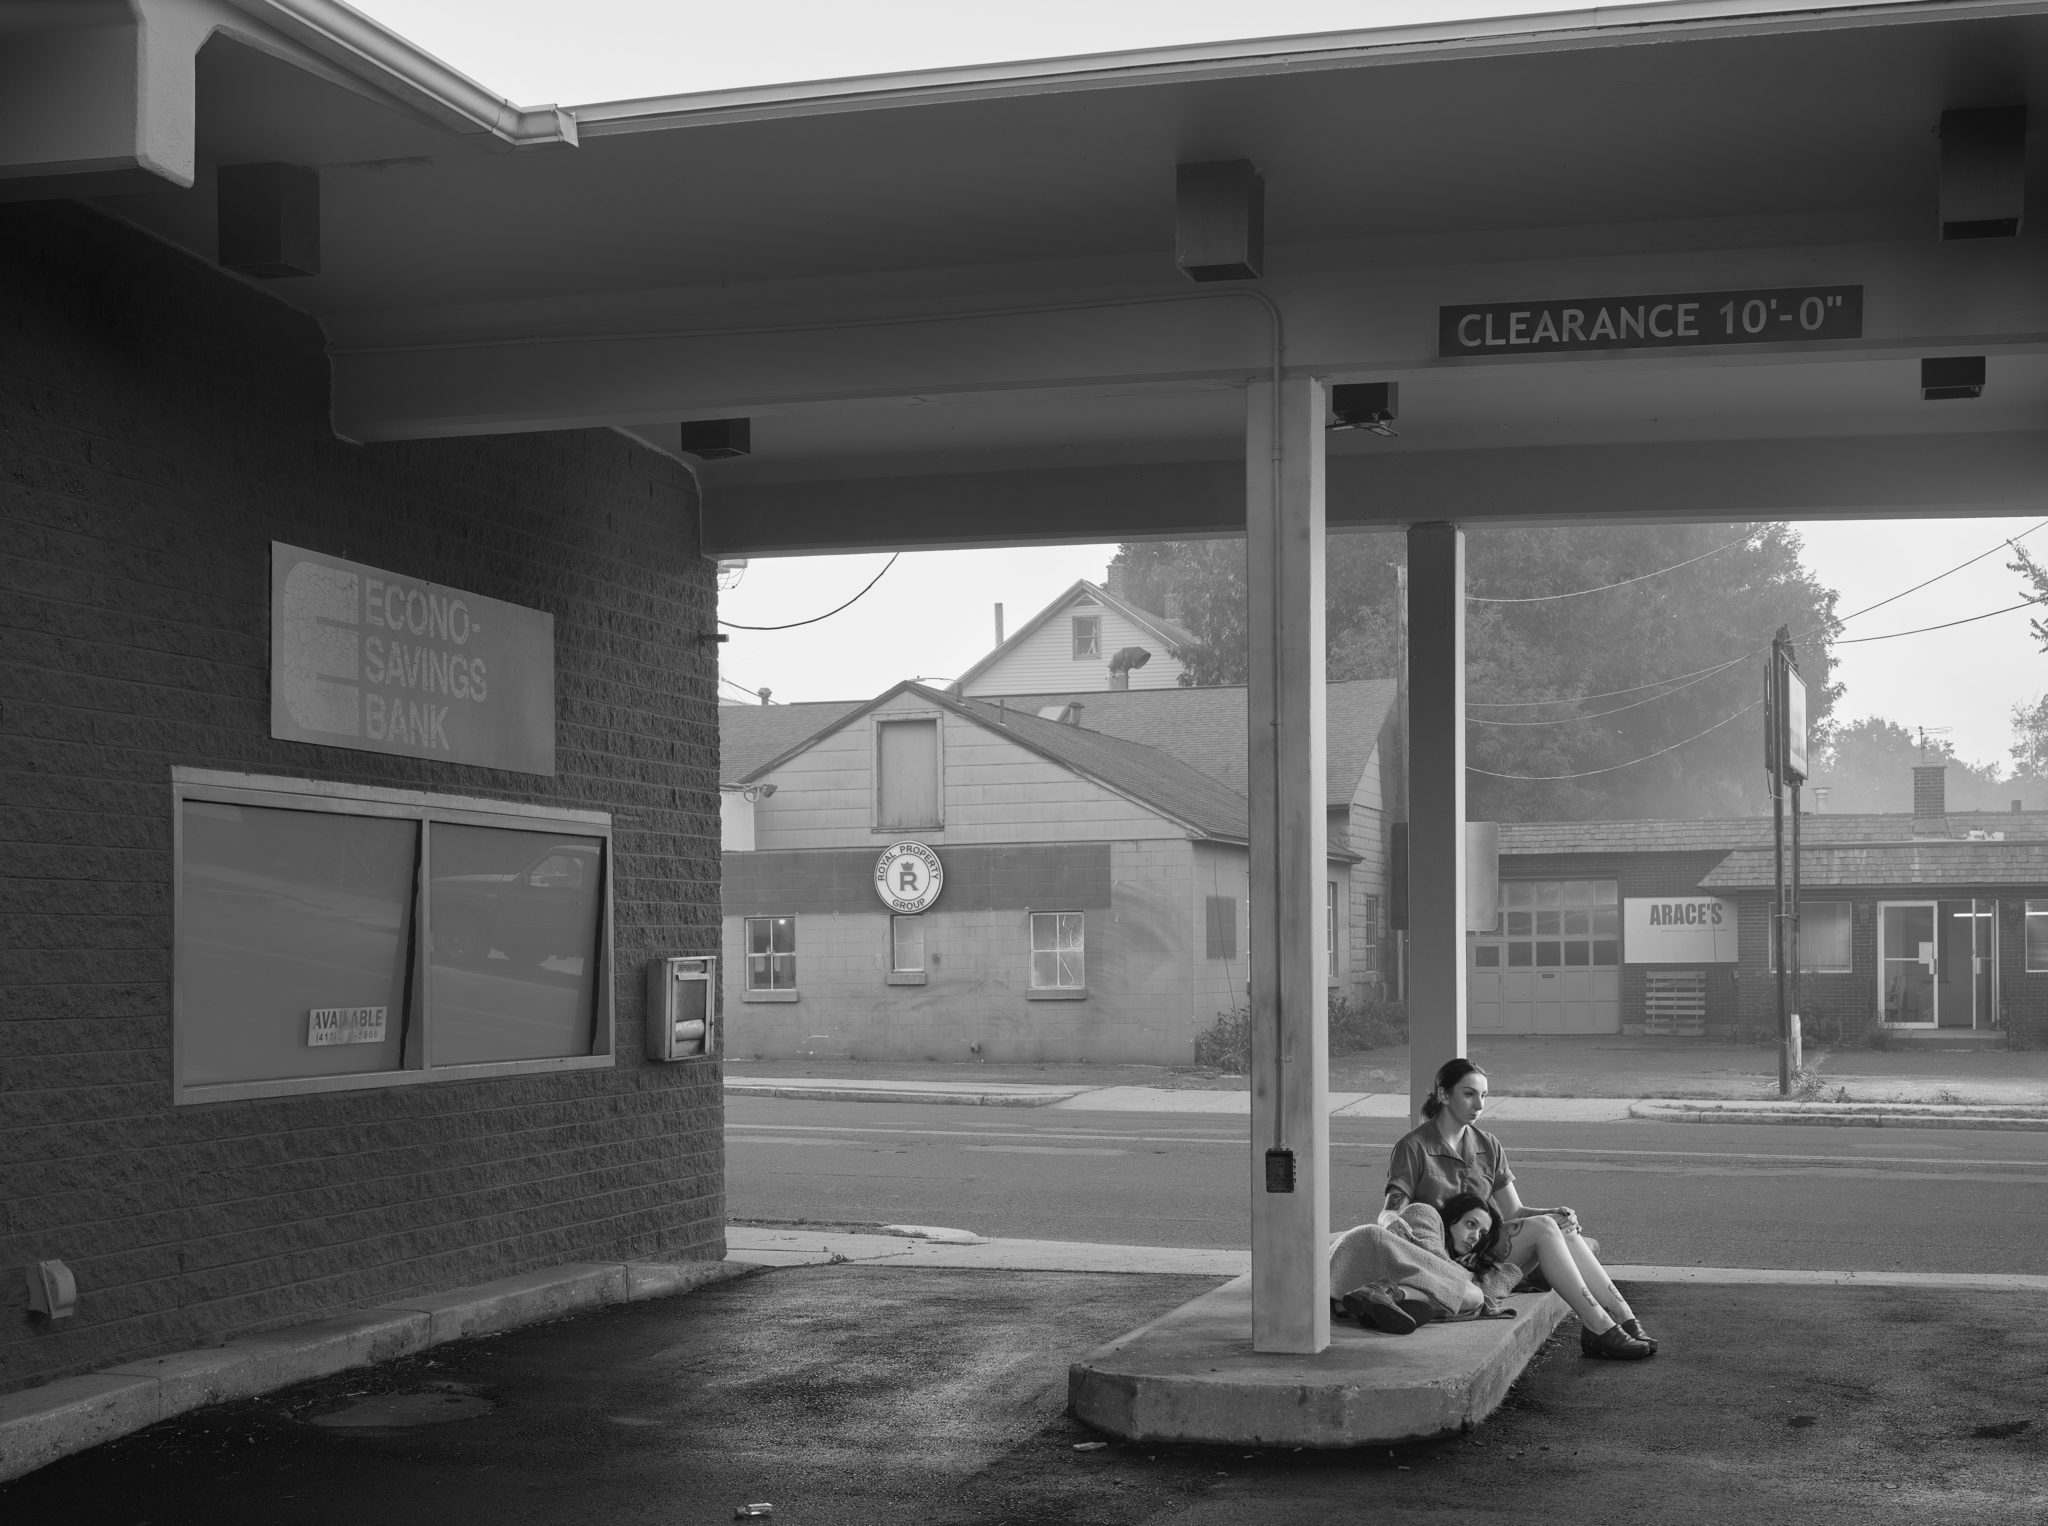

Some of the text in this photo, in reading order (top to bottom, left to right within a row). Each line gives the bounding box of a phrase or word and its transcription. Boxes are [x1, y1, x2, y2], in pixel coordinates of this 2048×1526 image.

[1457, 295, 1842, 347] CLEARANCE 10'-0"
[365, 634, 488, 703] SAVINGS
[366, 693, 450, 751] BANK
[878, 845, 939, 881] ROYAL PROPERTY
[899, 871, 919, 891] R
[892, 898, 925, 910] GROUP
[1649, 903, 1723, 925] ARACE'S
